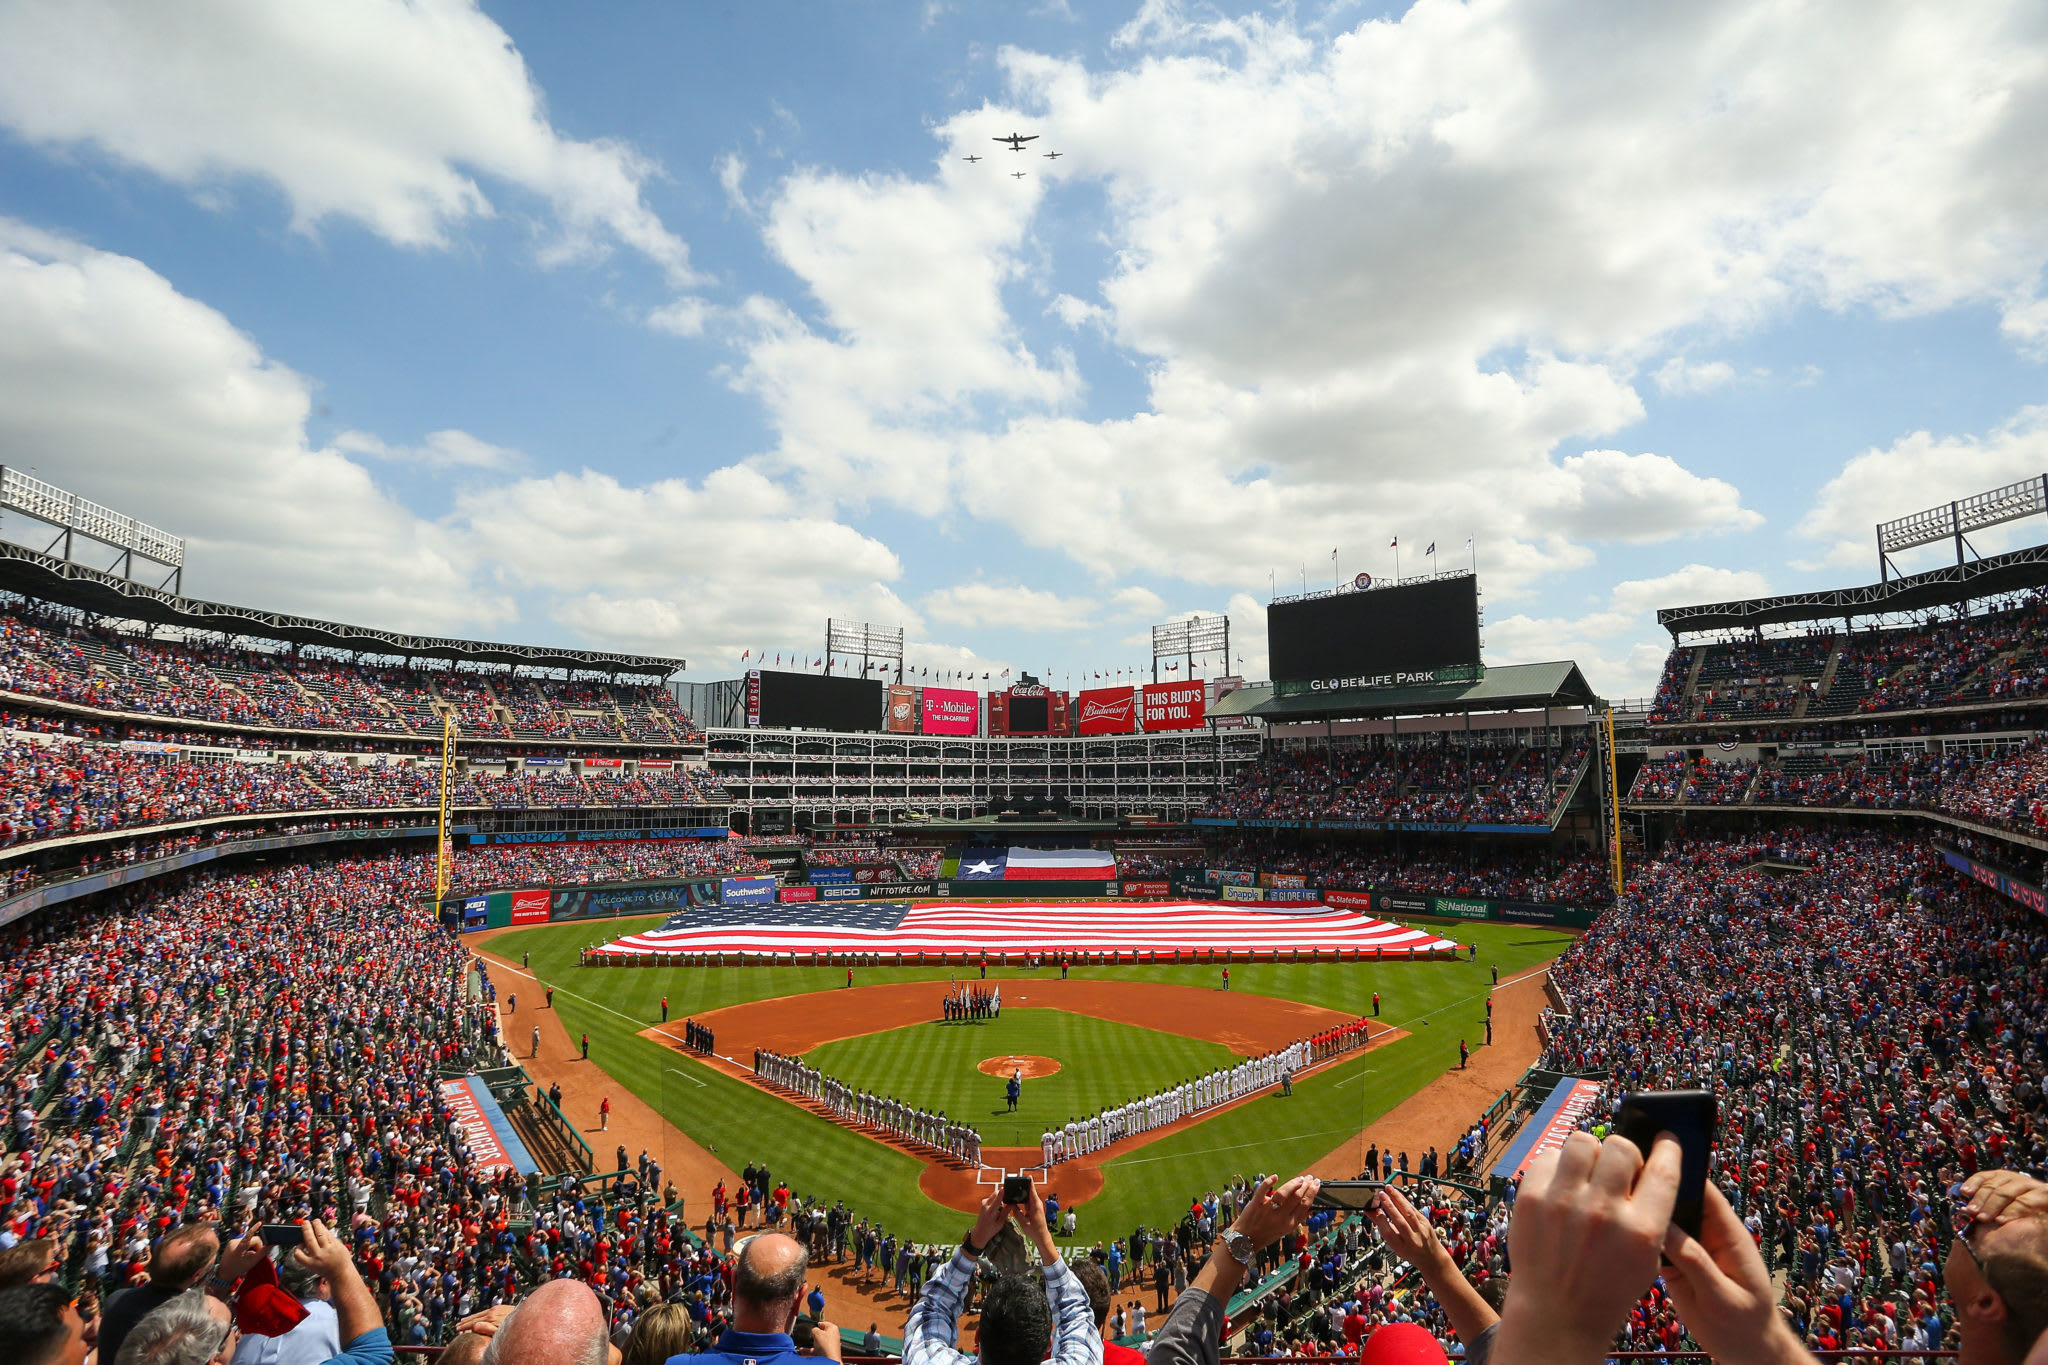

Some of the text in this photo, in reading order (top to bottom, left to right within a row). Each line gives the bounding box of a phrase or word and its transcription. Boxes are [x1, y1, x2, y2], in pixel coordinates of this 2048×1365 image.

[1362, 676, 1392, 686] LIFE
[1397, 672, 1434, 683] PARK
[1146, 689, 1201, 706] THIS BUD'S
[1084, 704, 1128, 716] Budweiser
[1146, 706, 1191, 720] FOR YOU.
[615, 831, 636, 839] TEXAS
[726, 887, 765, 897] Southwest
[824, 889, 860, 897] GEICO
[870, 884, 930, 896] NITTOTIRE.COM
[1228, 887, 1259, 900] Snapple
[1280, 892, 1300, 900] GLOBE
[593, 895, 632, 905] WELCOME
[647, 891, 680, 903] TEXAS
[1448, 902, 1487, 913] National
[449, 1095, 480, 1121] TEXAS
[460, 1120, 502, 1162] RANGERS
